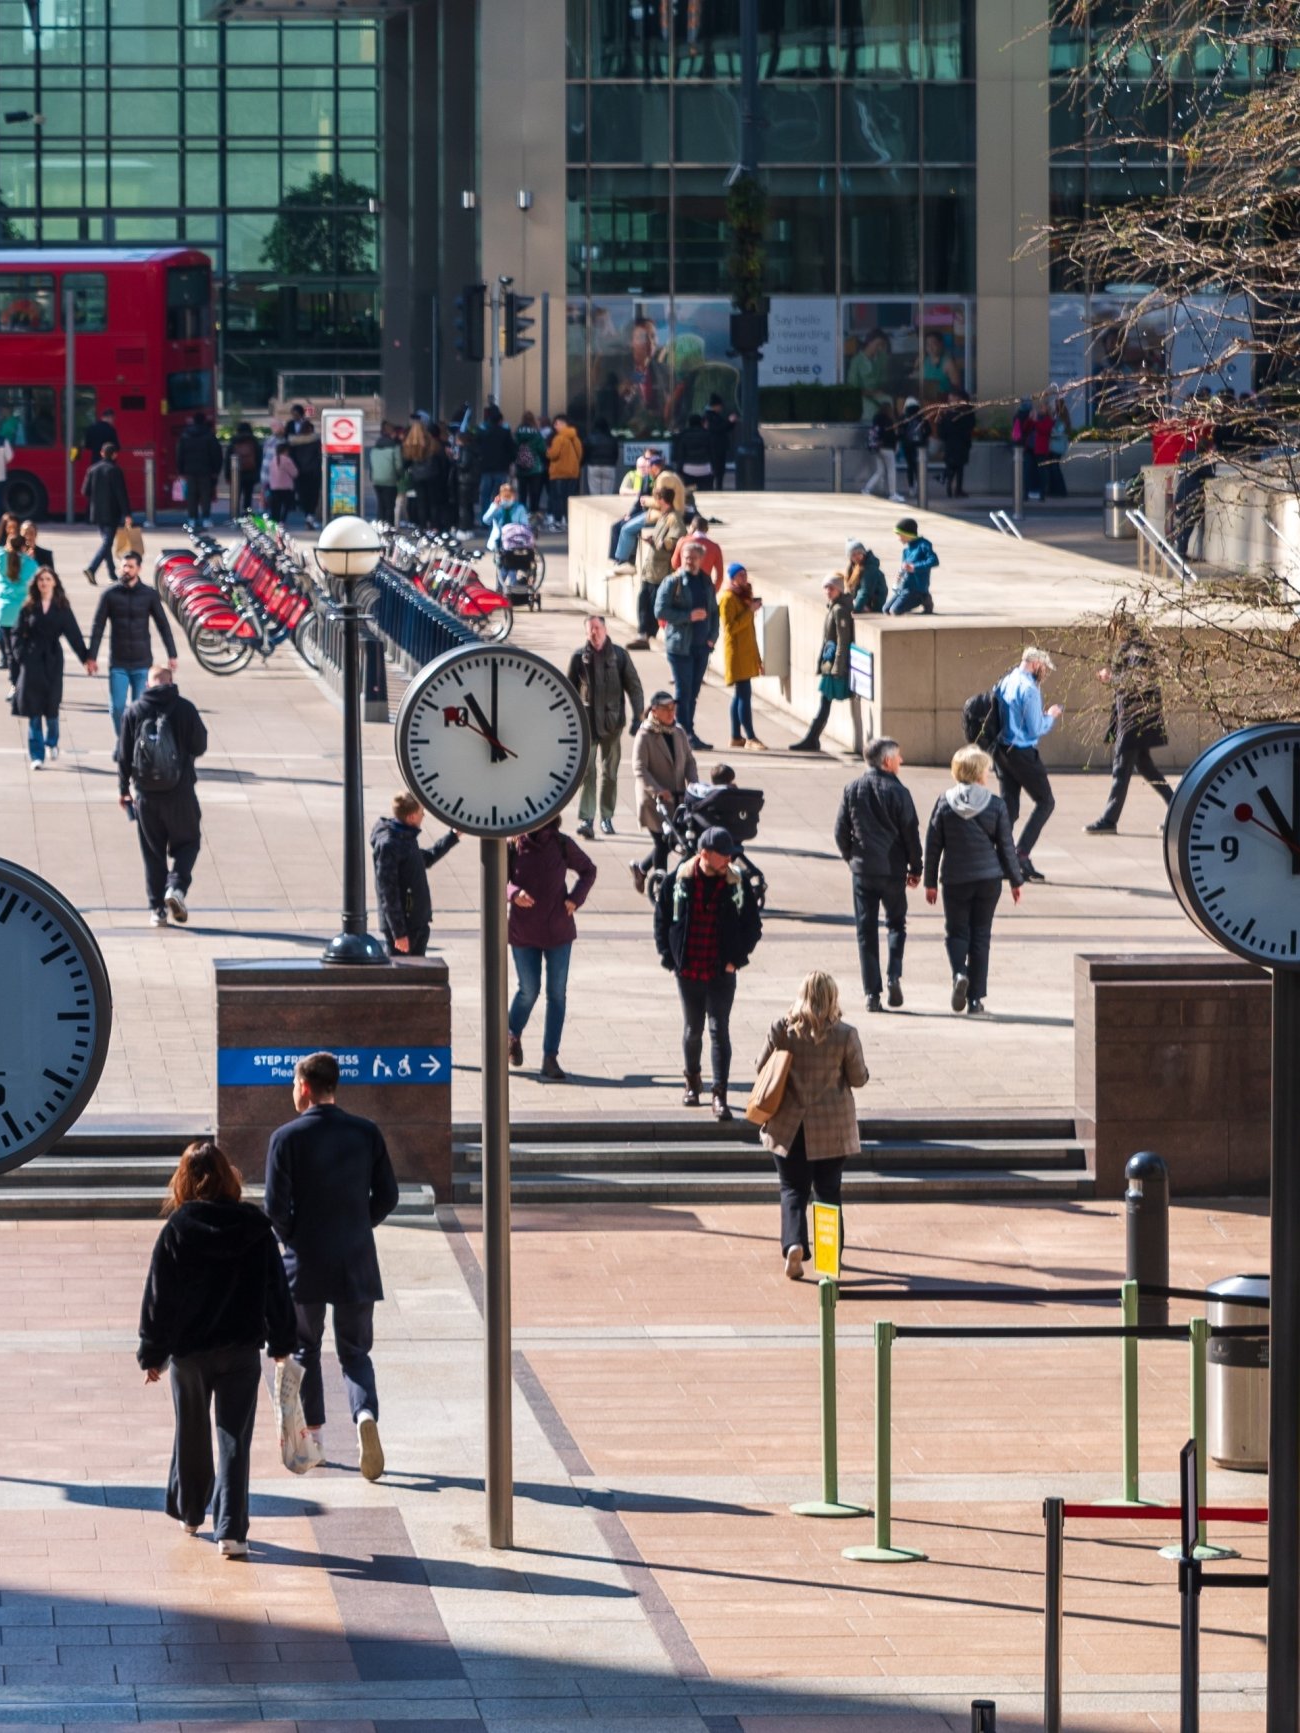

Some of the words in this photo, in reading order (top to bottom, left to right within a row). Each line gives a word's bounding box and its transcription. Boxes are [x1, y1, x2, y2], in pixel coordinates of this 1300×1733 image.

[795, 313, 820, 325] hello
[776, 342, 818, 356] banking
[773, 364, 810, 375] CHASE
[1220, 835, 1239, 863] 9
[254, 1055, 282, 1065] STEP
[271, 1067, 294, 1077] Plea
